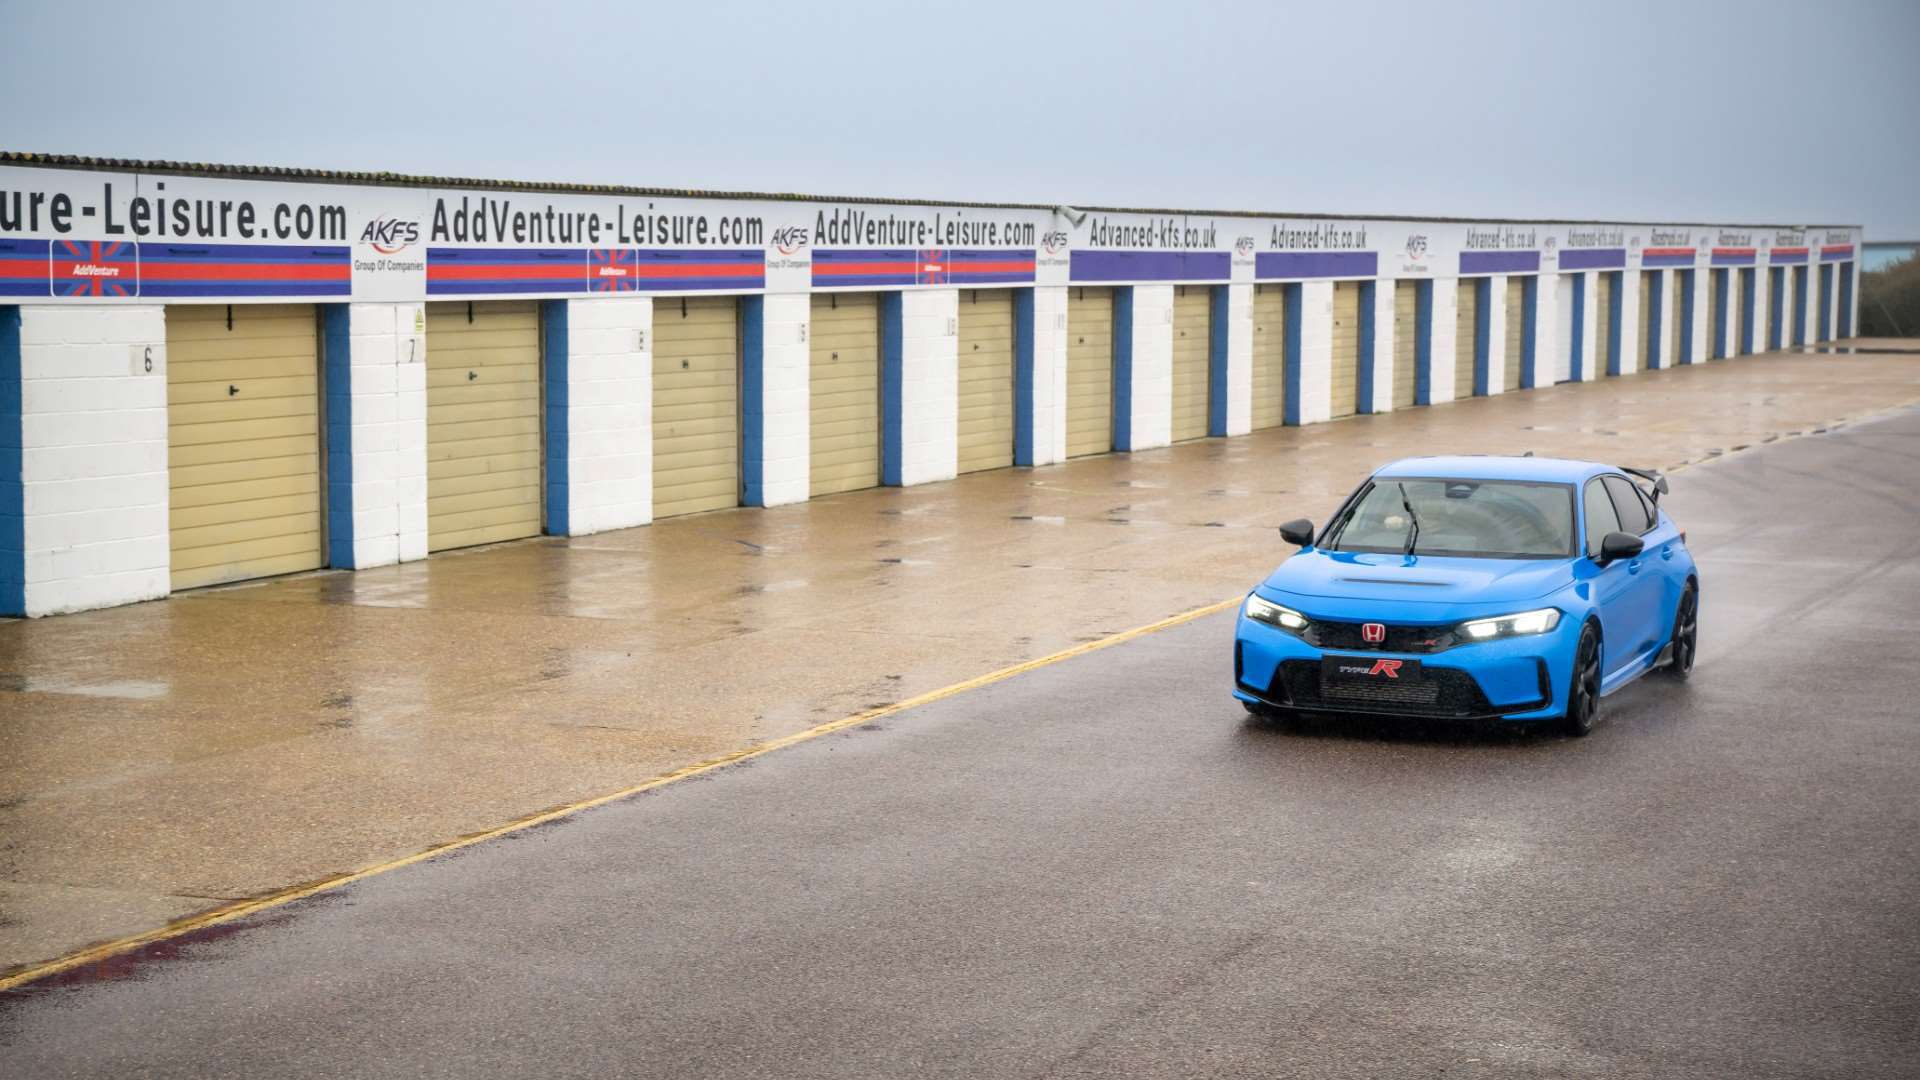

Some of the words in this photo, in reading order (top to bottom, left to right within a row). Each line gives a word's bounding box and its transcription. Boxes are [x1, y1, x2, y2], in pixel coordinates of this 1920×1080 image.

[360, 218, 419, 244] AKFS
[430, 196, 763, 246] AddVenture-Leisure.com
[813, 209, 1035, 246] AddVenture-Leisure.com
[1089, 217, 1216, 249] Advanced-kfs.co.uk
[770, 227, 808, 247] AKFS
[1271, 223, 1367, 250] Advanced-kfs.co.uk
[72, 264, 119, 276] AddVenture
[354, 259, 376, 272] Group
[387, 259, 424, 272] Companies
[144, 347, 153, 372] 6
[1368, 659, 1403, 678] R
